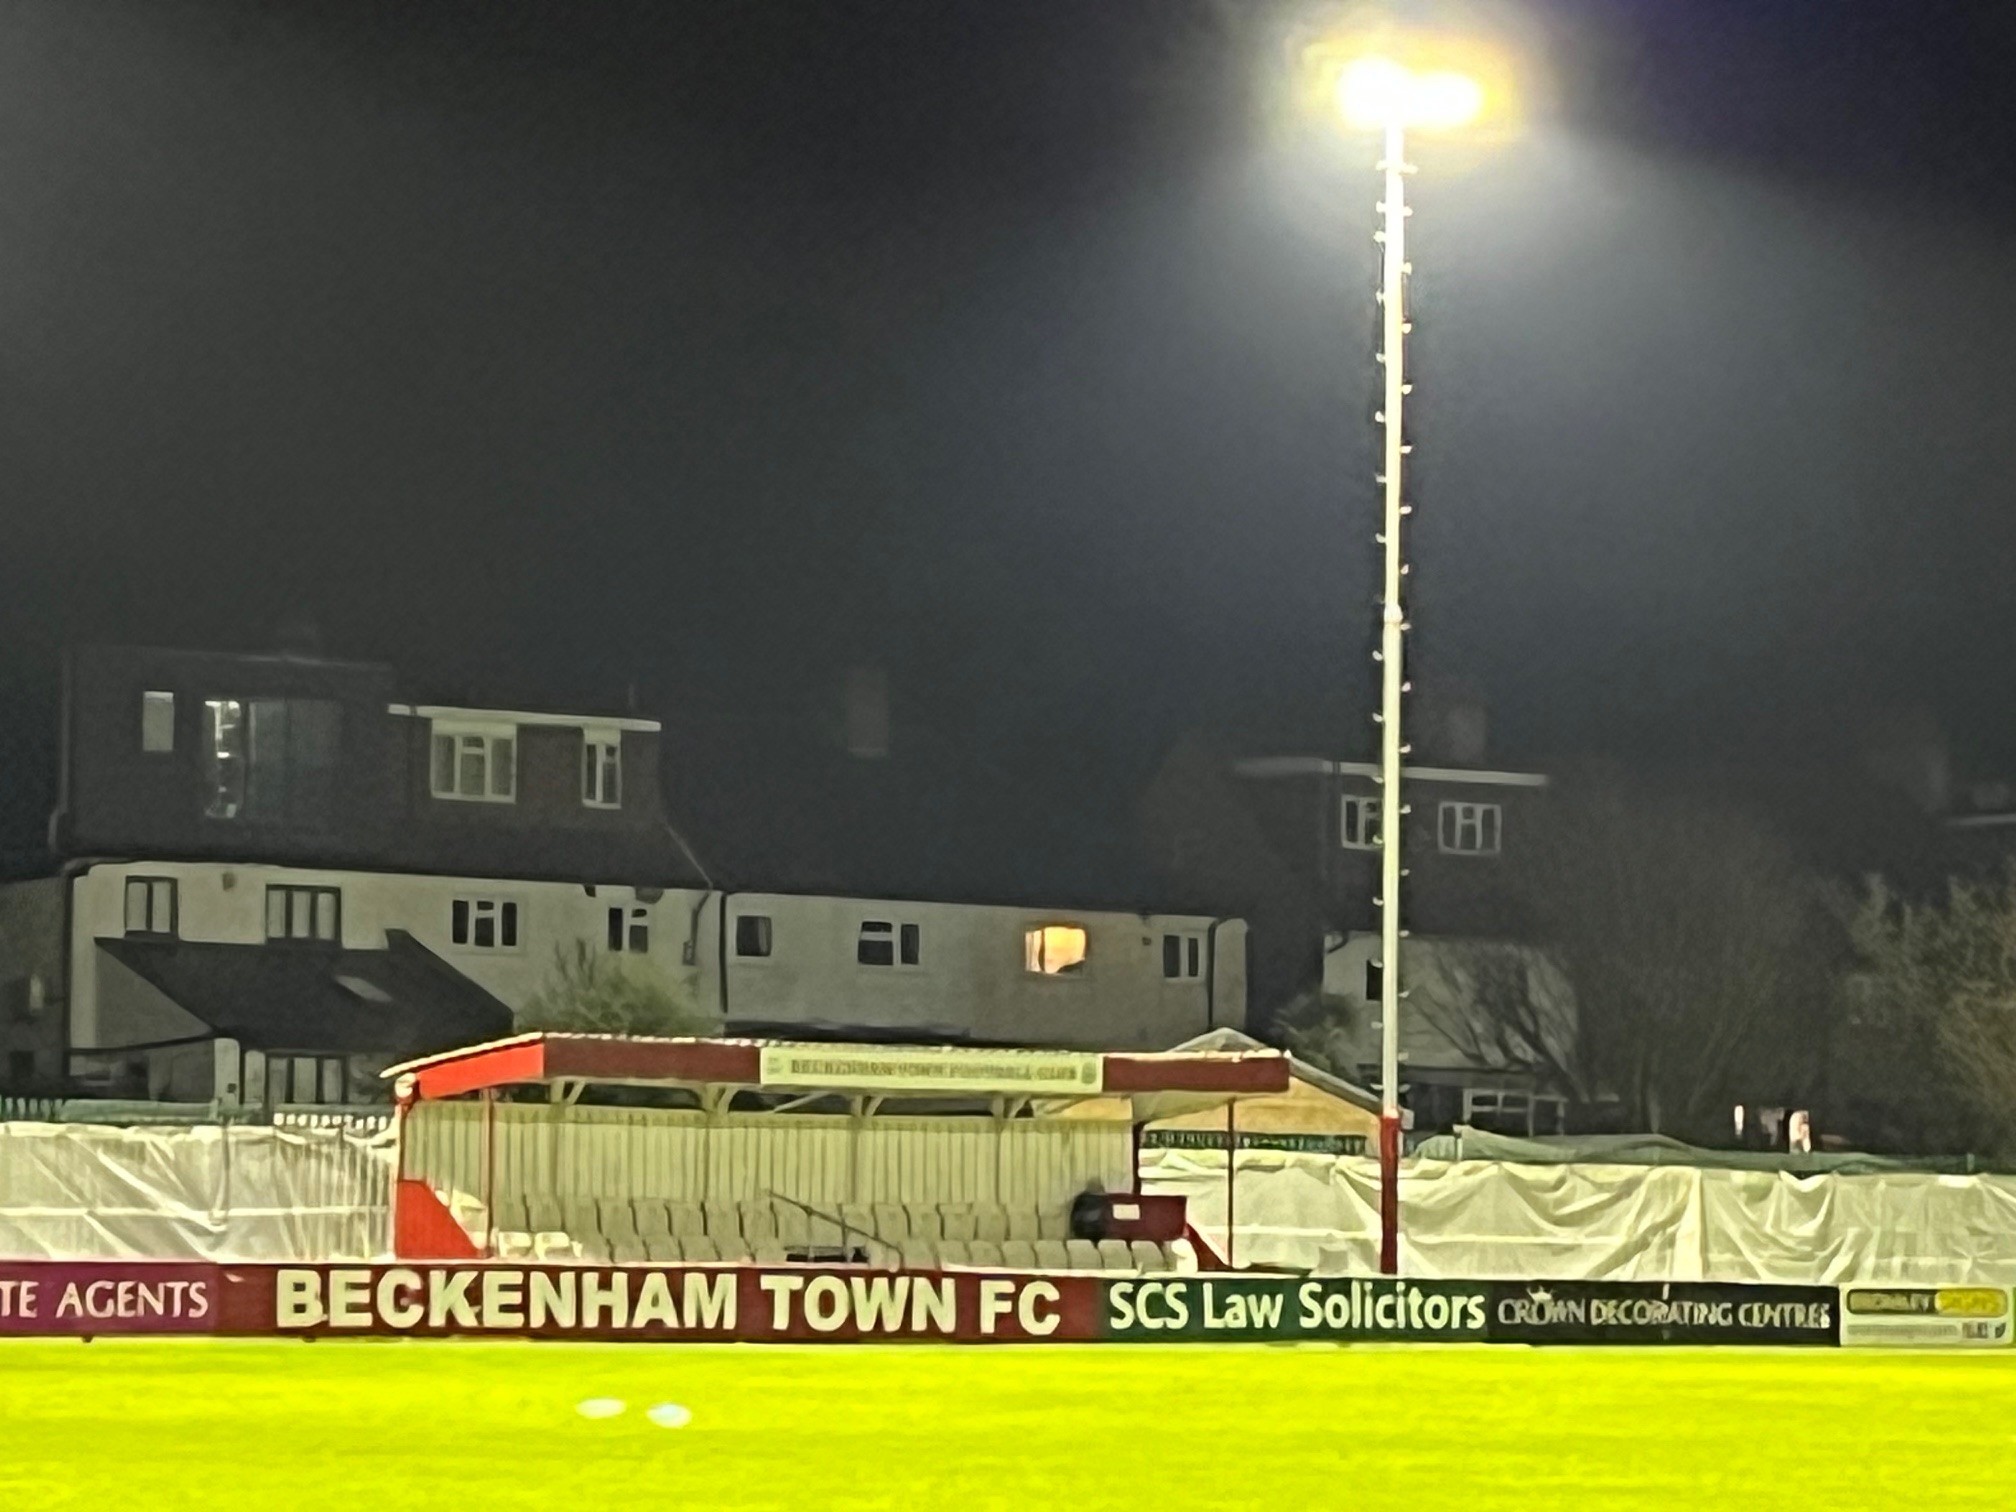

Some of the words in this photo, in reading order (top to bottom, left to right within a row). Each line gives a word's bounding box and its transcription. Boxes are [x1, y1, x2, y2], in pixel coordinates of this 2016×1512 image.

[0, 1280, 39, 1318] TE
[56, 1280, 209, 1319] AGENTS
[276, 1268, 738, 1330] BECKENHAM
[759, 1274, 957, 1333] TOWN
[979, 1280, 1061, 1336] FC
[1109, 1281, 1190, 1330] SCS
[1202, 1281, 1285, 1330] Law
[1298, 1279, 1486, 1330] Solicitors
[1497, 1298, 1586, 1326] CROWN
[1590, 1298, 1734, 1328] DECORATING
[1738, 1302, 1832, 1330] CENTRES
